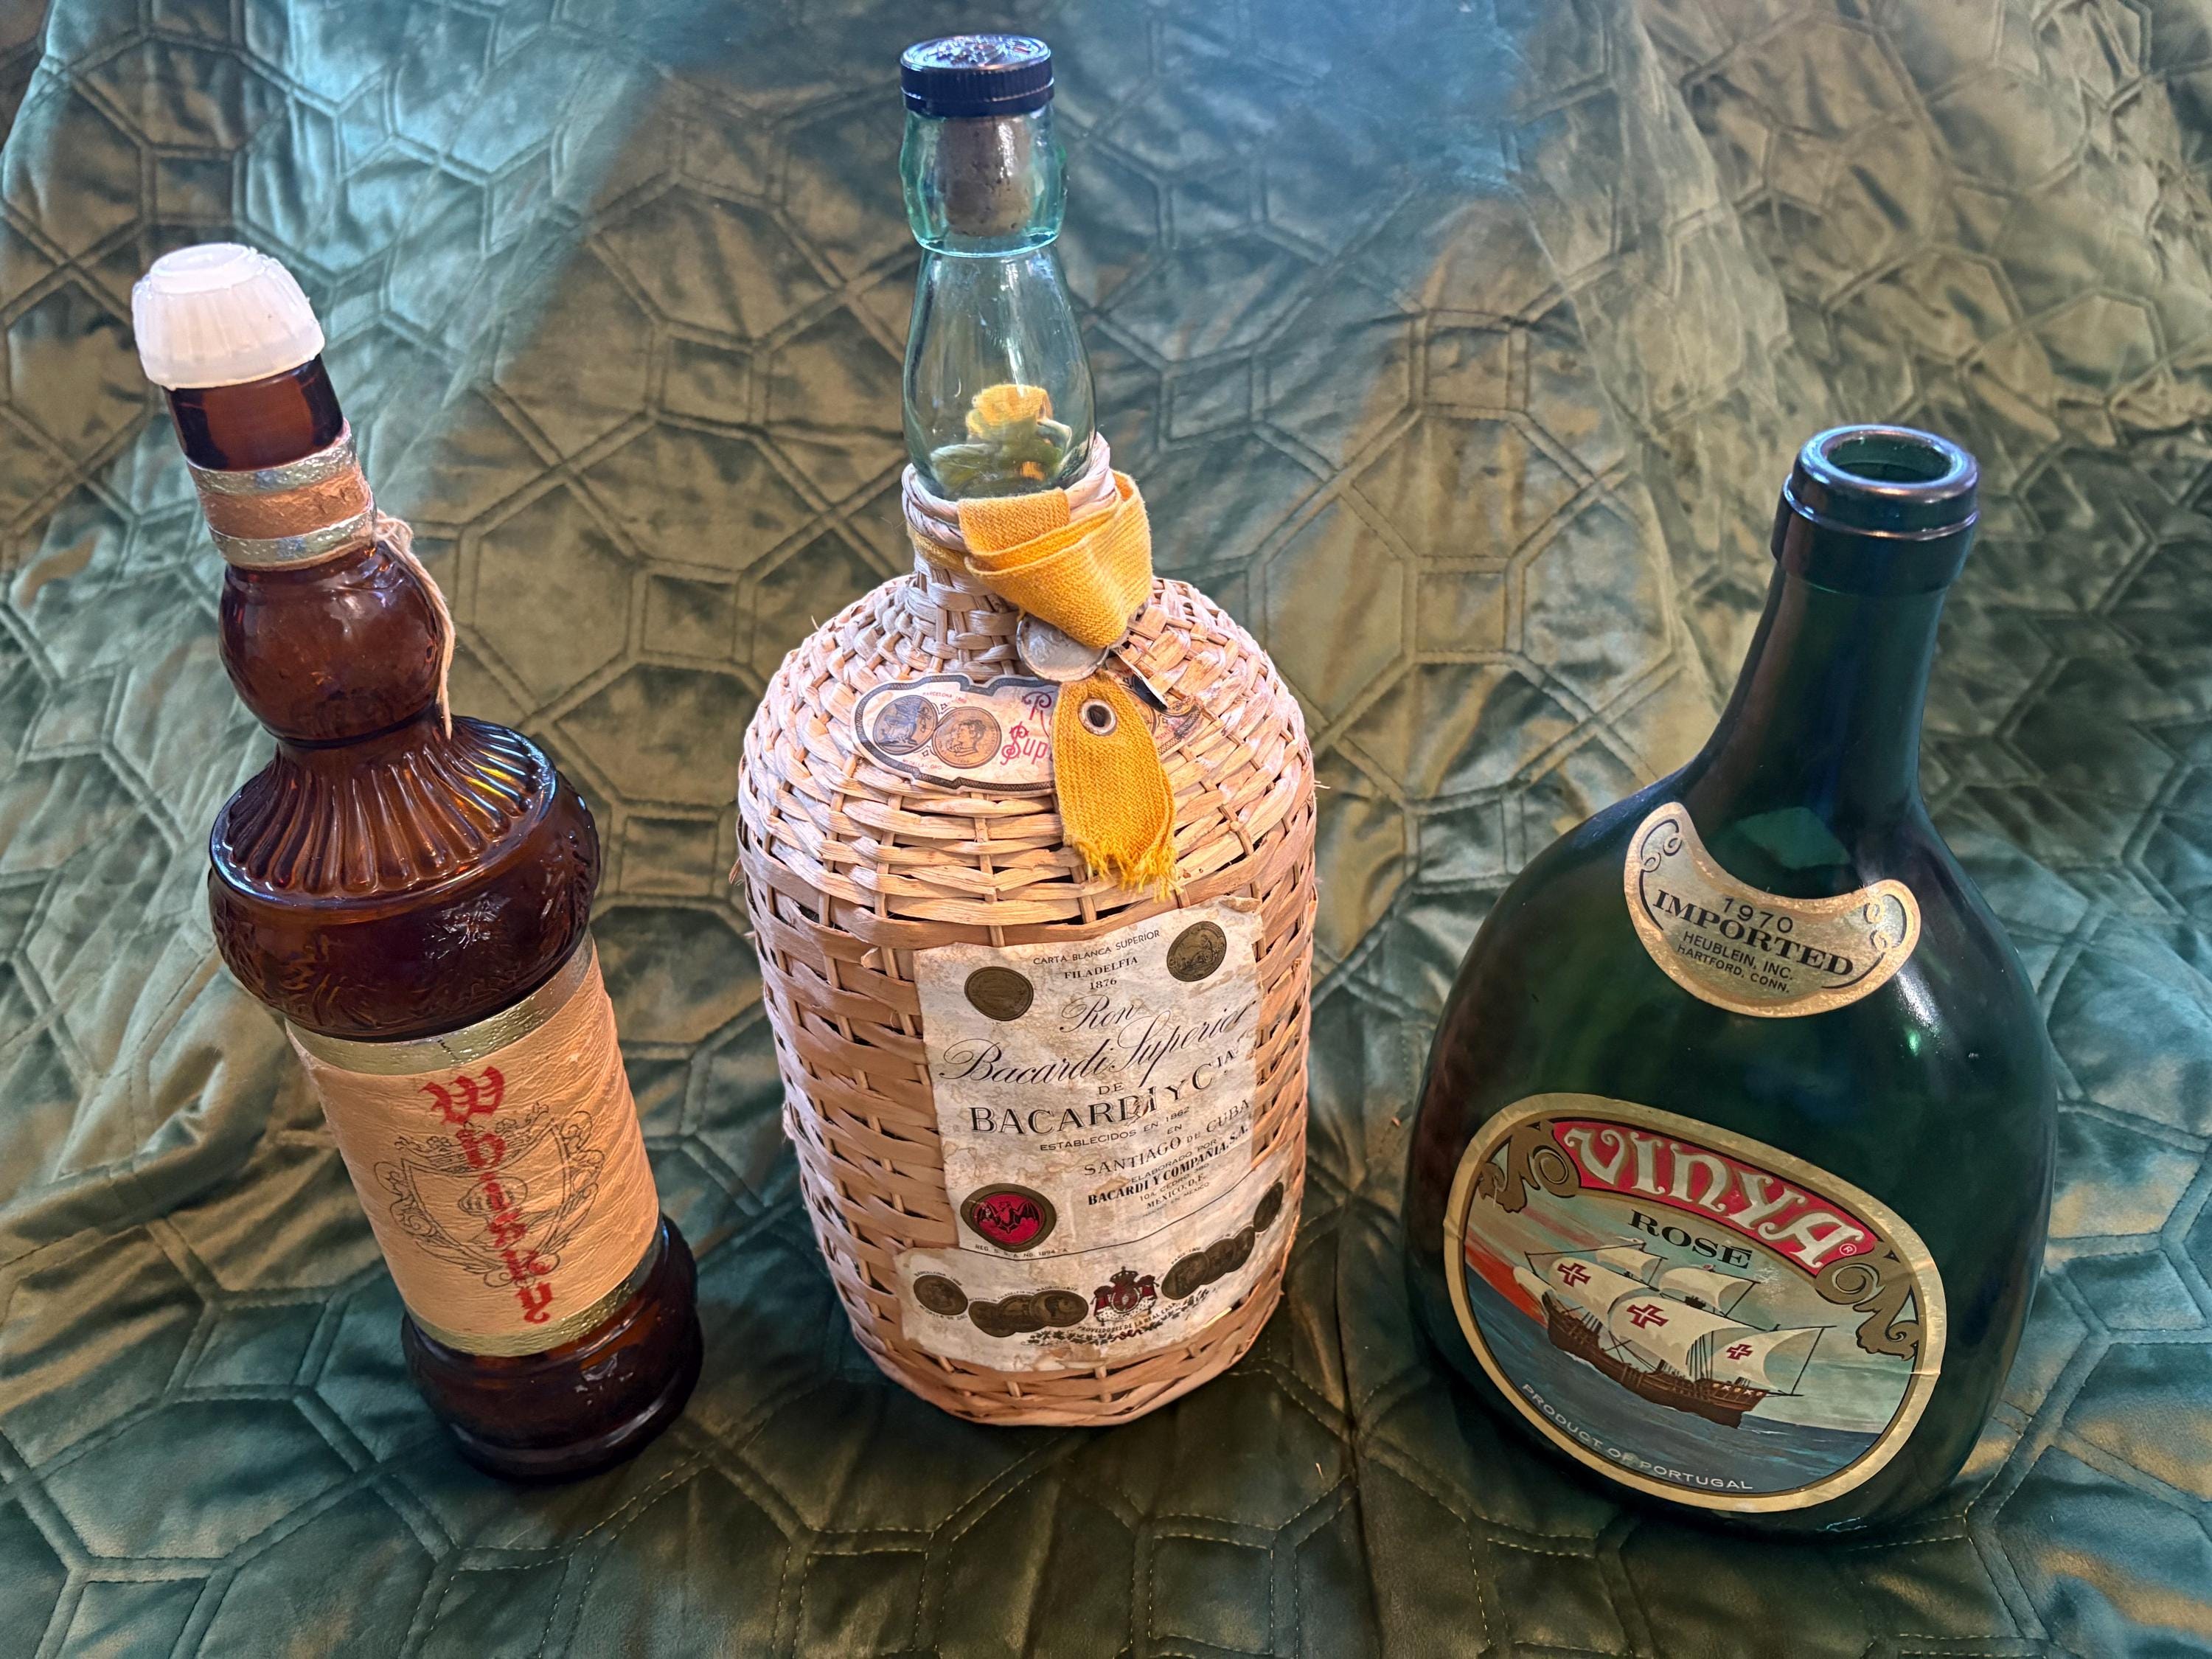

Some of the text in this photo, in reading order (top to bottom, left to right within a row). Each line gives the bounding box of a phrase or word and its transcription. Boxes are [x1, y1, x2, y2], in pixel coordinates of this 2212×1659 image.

[1652, 889, 1854, 975] IMPORTED
[1724, 897, 1793, 933] 1970
[1033, 930, 1160, 965] CARTA BLANCA SUPERIOR
[1064, 956, 1138, 979] FILADELFIA
[1677, 943, 1790, 993] HARTFORD, CONN.
[1683, 931, 1793, 981] HEUBLEIN, INC.
[1089, 978, 1117, 990] 1876
[1060, 995, 1137, 1033] Ron
[939, 1000, 1256, 1088] Bacardi Superior
[968, 1085, 1158, 1135] BACARDI
[1164, 1079, 1187, 1102] Y
[1099, 1082, 1125, 1095] DE
[1040, 1106, 1190, 1151] ESTABLECIDOS EN 1862
[1084, 1099, 1250, 1175] SANTIAGO DE CUBA
[1167, 1124, 1182, 1135] EN
[1132, 1138, 1217, 1183] ELABORADO POR
[1088, 1180, 1148, 1206] BACARDI
[1152, 1172, 1161, 1185] Y
[1160, 1174, 1190, 1192] CEDRO
[1522, 1383, 1753, 1490] PRODUCT OF PORTUGAL
